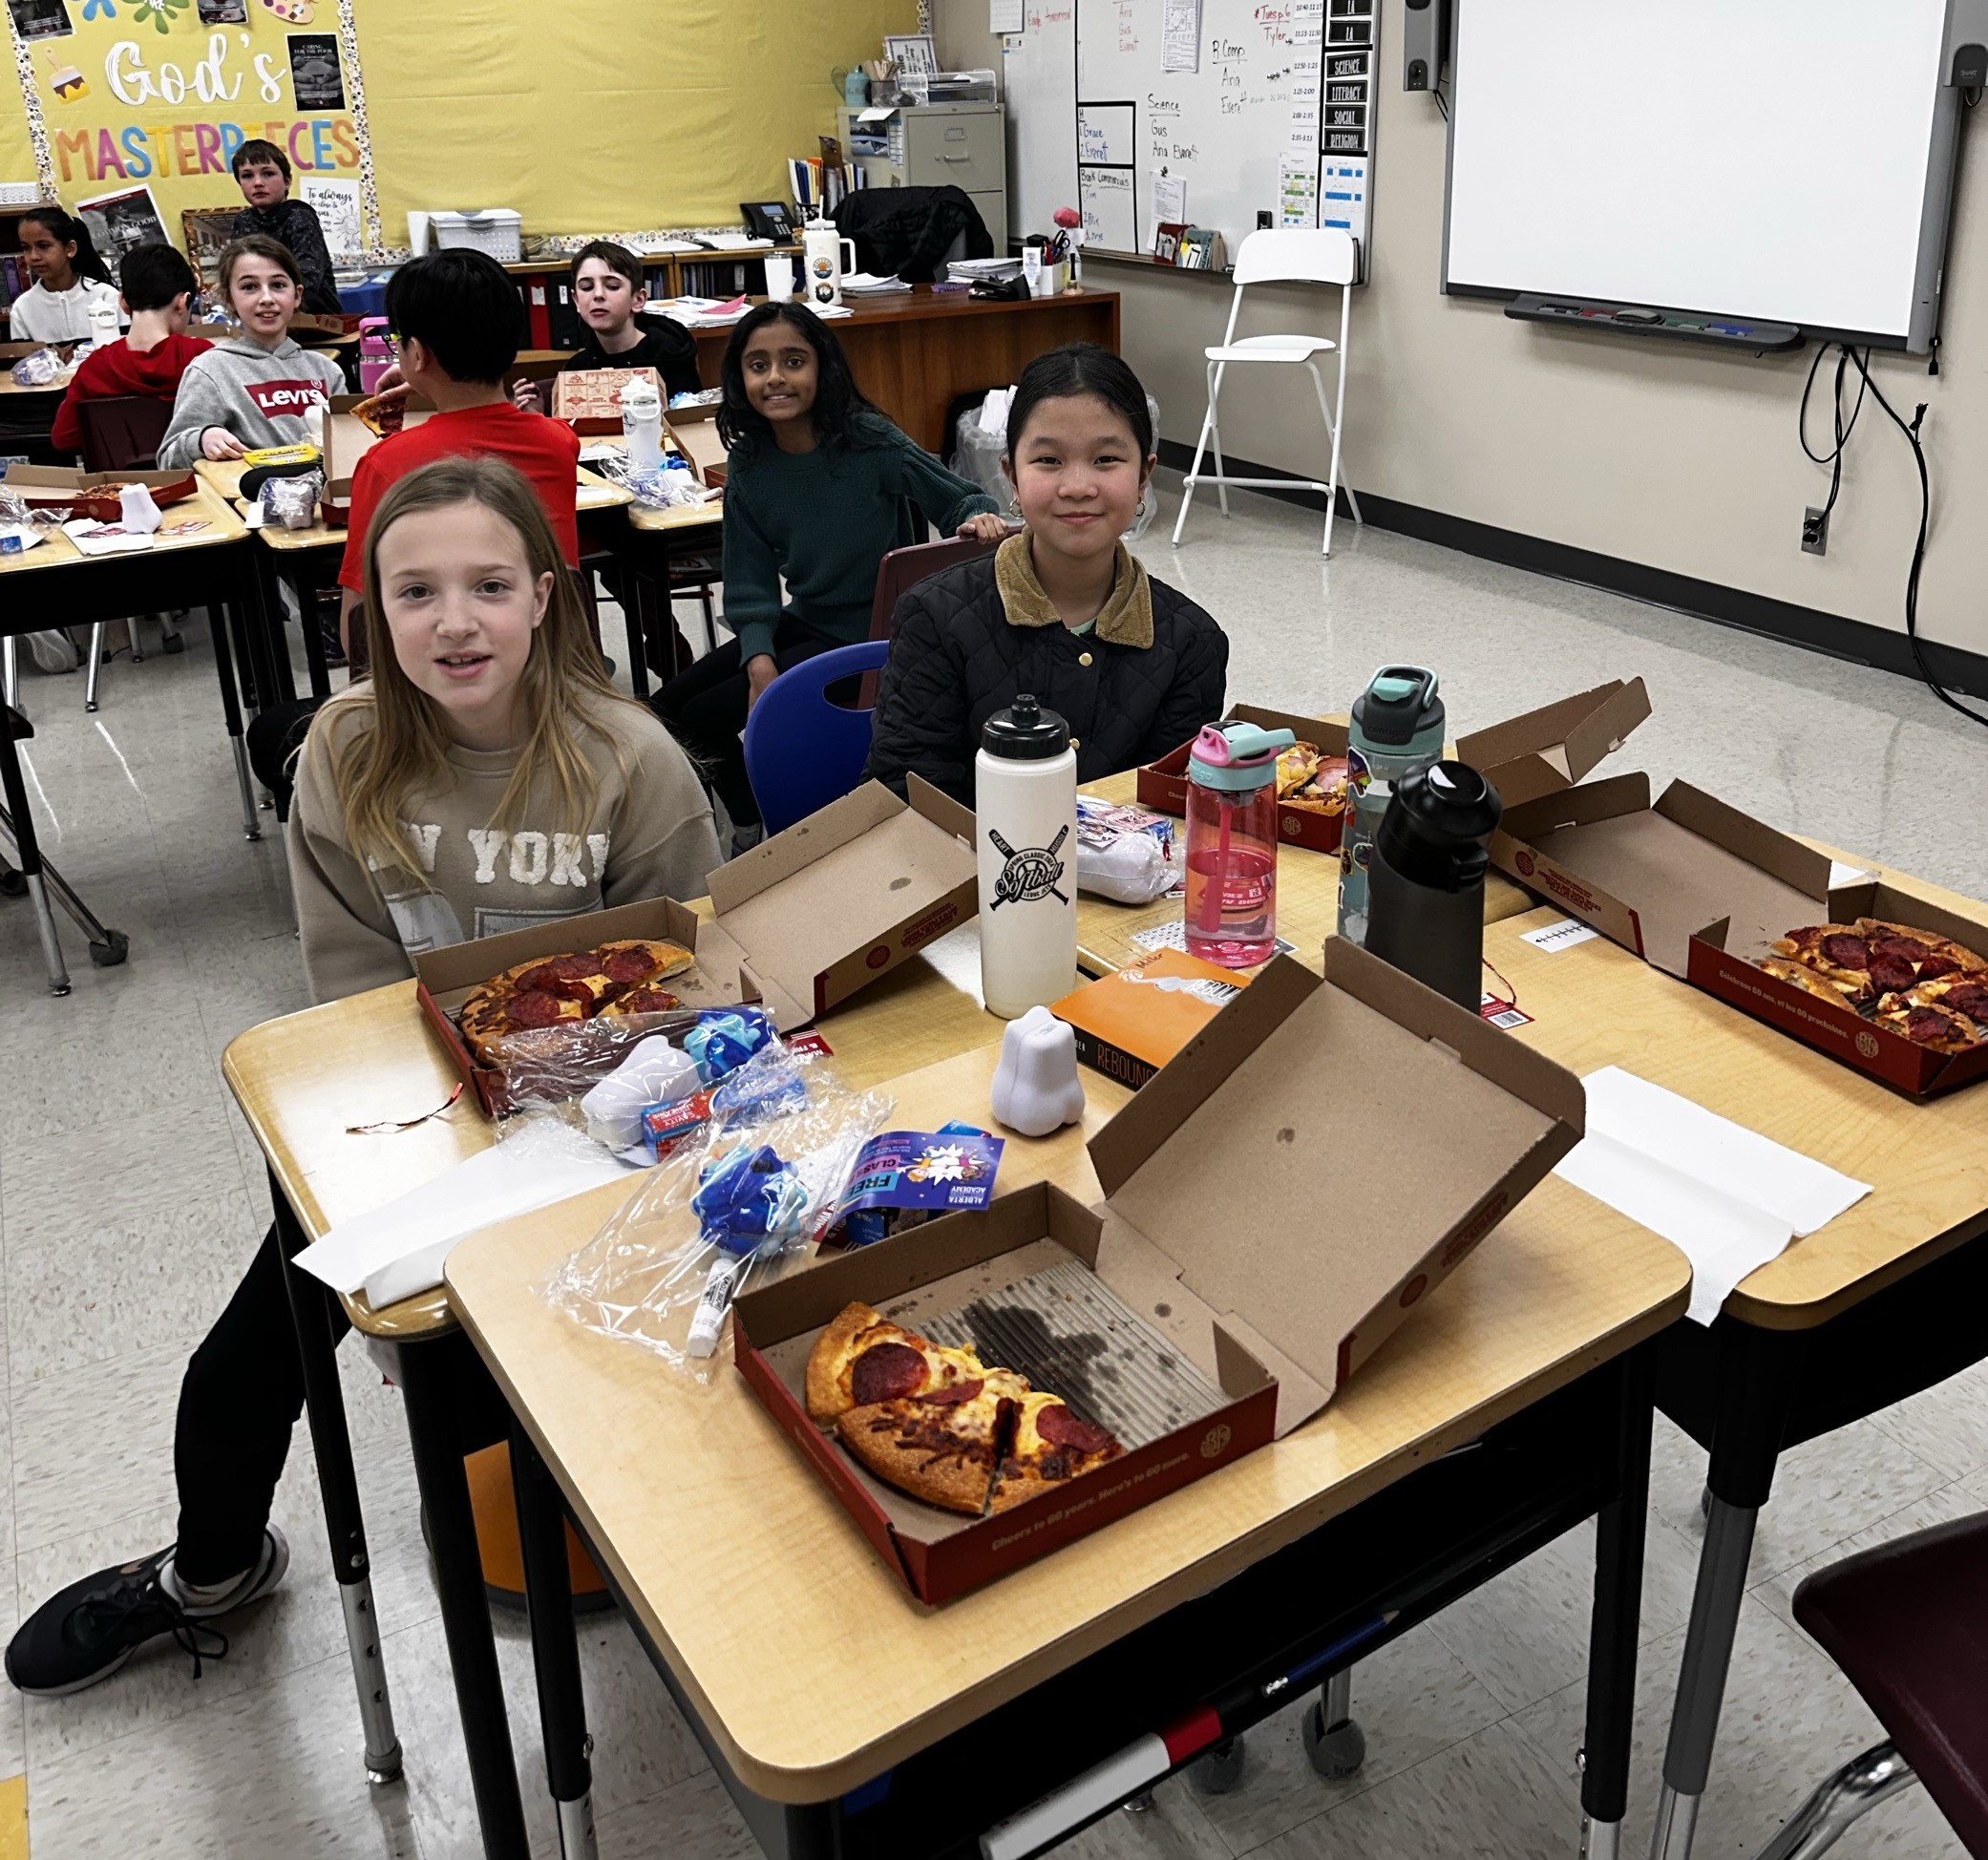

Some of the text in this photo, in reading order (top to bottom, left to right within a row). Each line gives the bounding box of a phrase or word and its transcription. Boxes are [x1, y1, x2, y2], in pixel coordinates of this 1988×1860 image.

[1347, 0, 1355, 15] LA
[1263, 27, 1286, 47] Tyler
[1345, 27, 1354, 41] LA
[1222, 39, 1245, 64] Comp
[105, 33, 286, 105] God's
[1334, 58, 1361, 75] SCIENCE
[1332, 86, 1362, 101] LITERACY
[1148, 93, 1181, 113] Science
[1334, 111, 1356, 125] SOCIAL
[1083, 123, 1103, 137] Grace
[1152, 119, 1168, 137] Gus
[1085, 140, 1108, 161] Everett
[1330, 134, 1359, 149] RELIGION
[307, 187, 353, 205] To always
[131, 216, 157, 228] GOOD
[1168, 791, 1187, 800] Cheer
[991, 832, 1010, 854] HEART
[1008, 856, 1025, 872] SPRING
[995, 861, 1065, 903] Softball
[1751, 985, 1762, 998] 60
[1777, 999, 1786, 1007] et
[1786, 1003, 1796, 1014] les
[1796, 1006, 1808, 1019] 60
[847, 1174, 891, 1197] FREE
[951, 1185, 986, 1194] ACADEMY
[992, 1452, 1191, 1551] Cheers to 60 years. Here's to 60 more.
